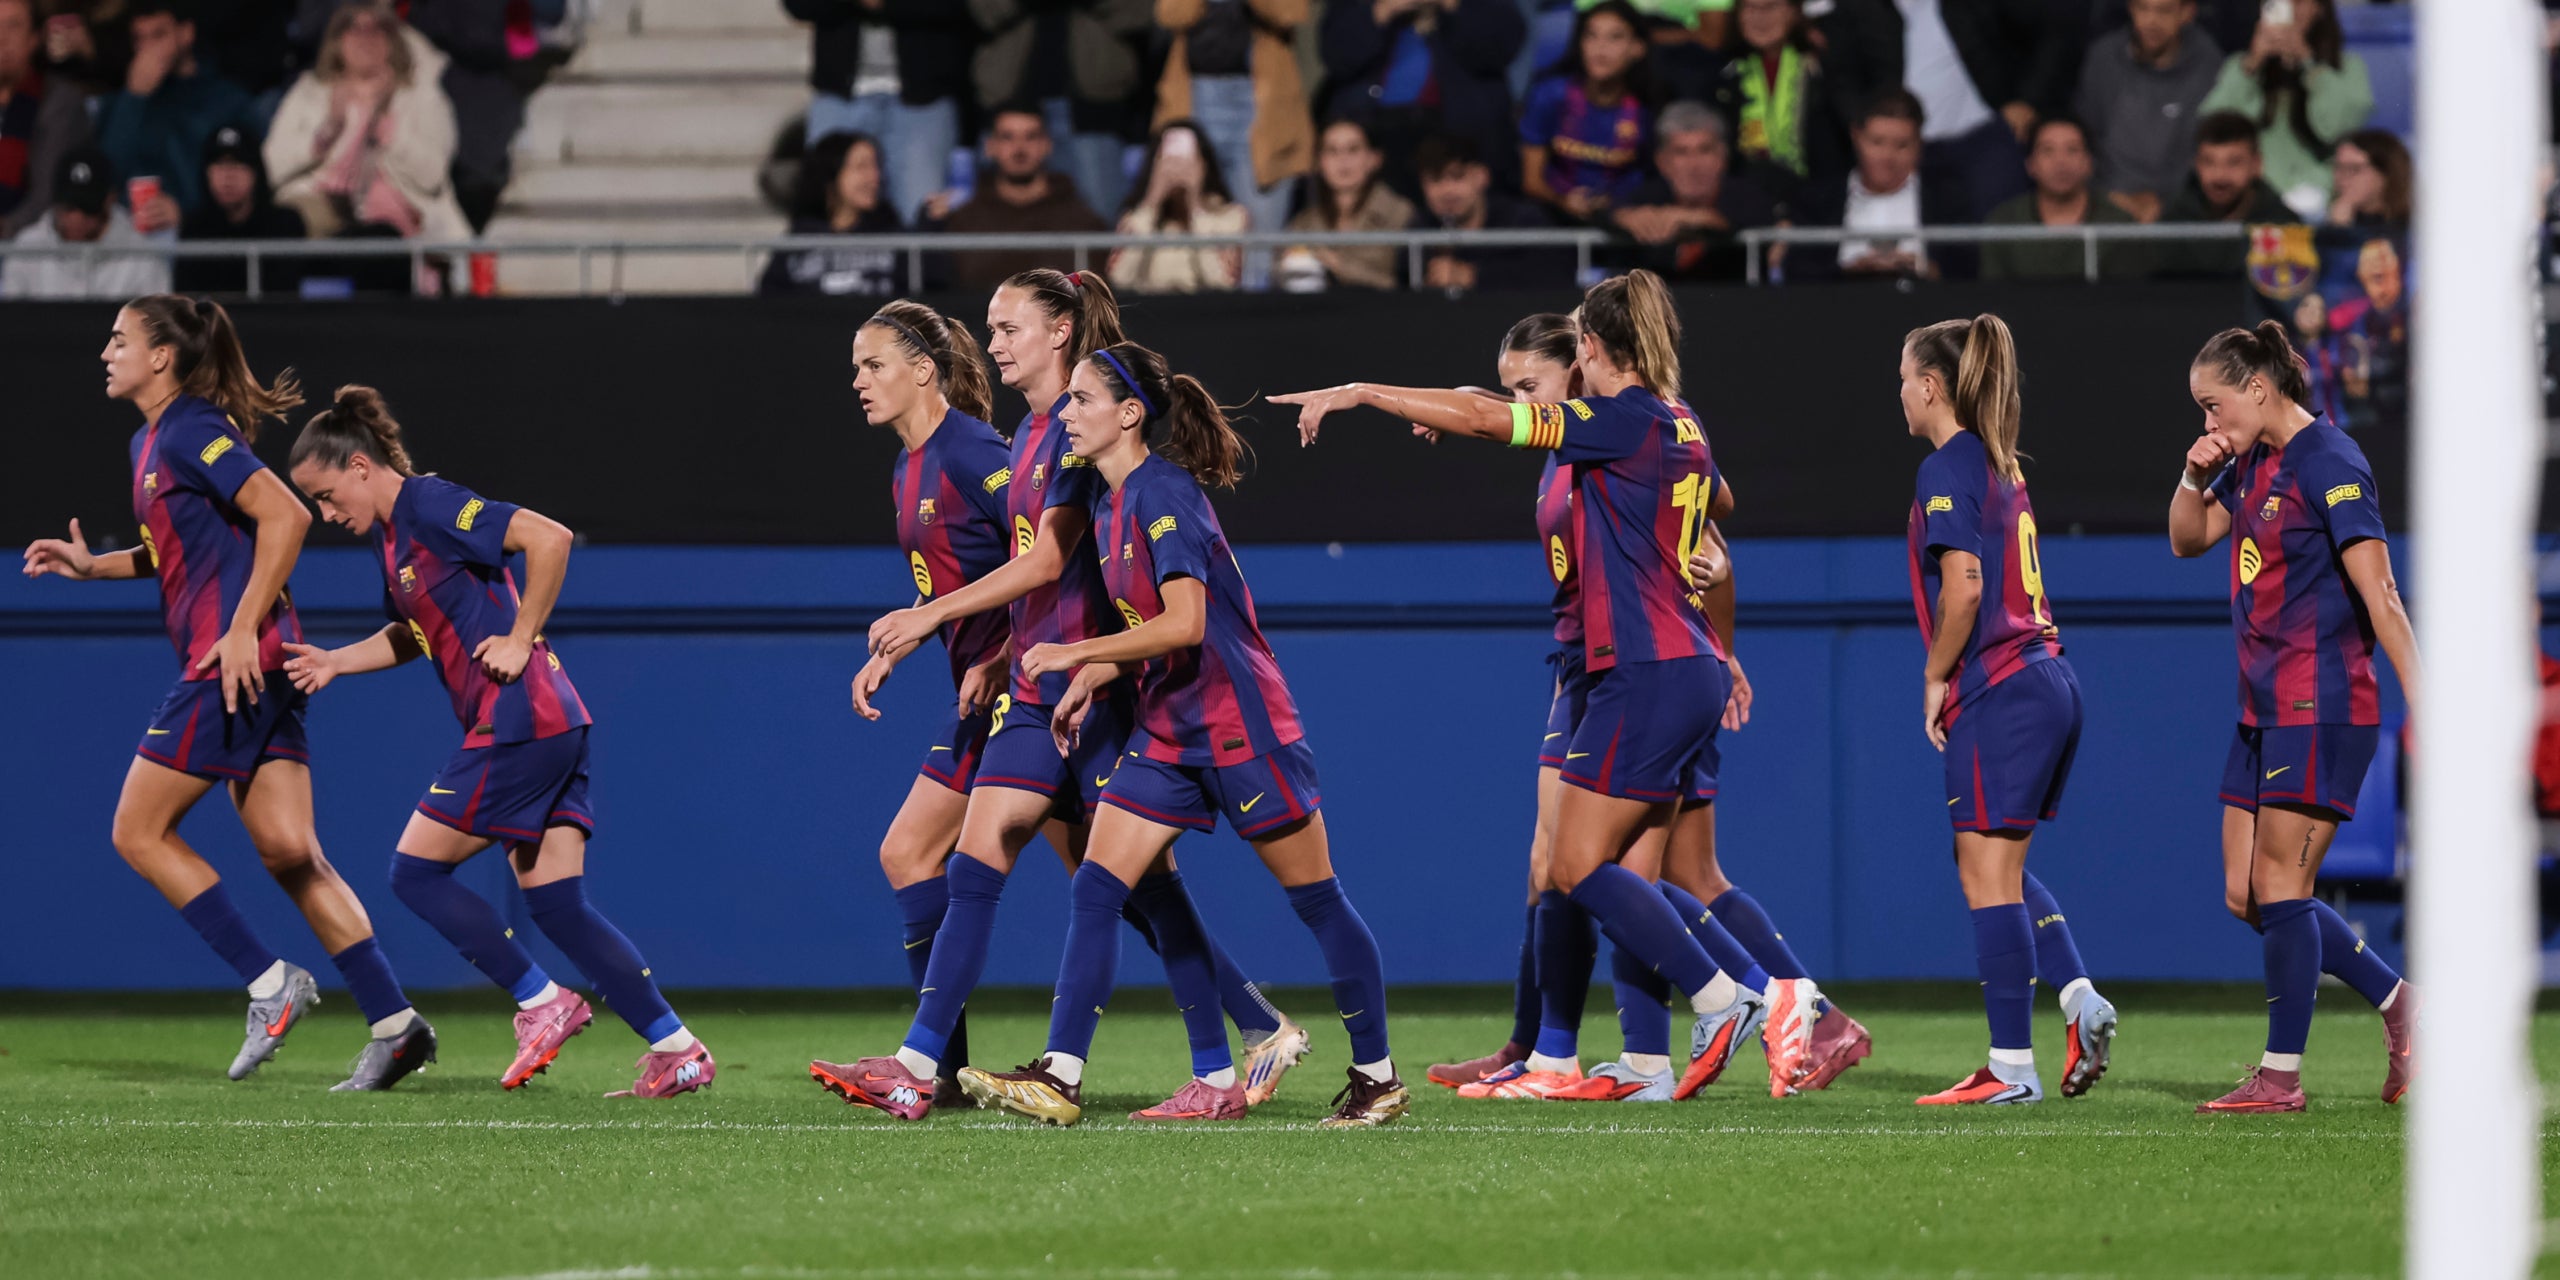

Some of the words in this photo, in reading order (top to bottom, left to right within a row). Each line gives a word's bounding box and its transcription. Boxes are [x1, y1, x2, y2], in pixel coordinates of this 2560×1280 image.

[1150, 518, 1177, 540] BIMBO
[2326, 485, 2361, 505] BIMBO
[1672, 472, 1711, 588] 11
[2018, 511, 2052, 626] 9
